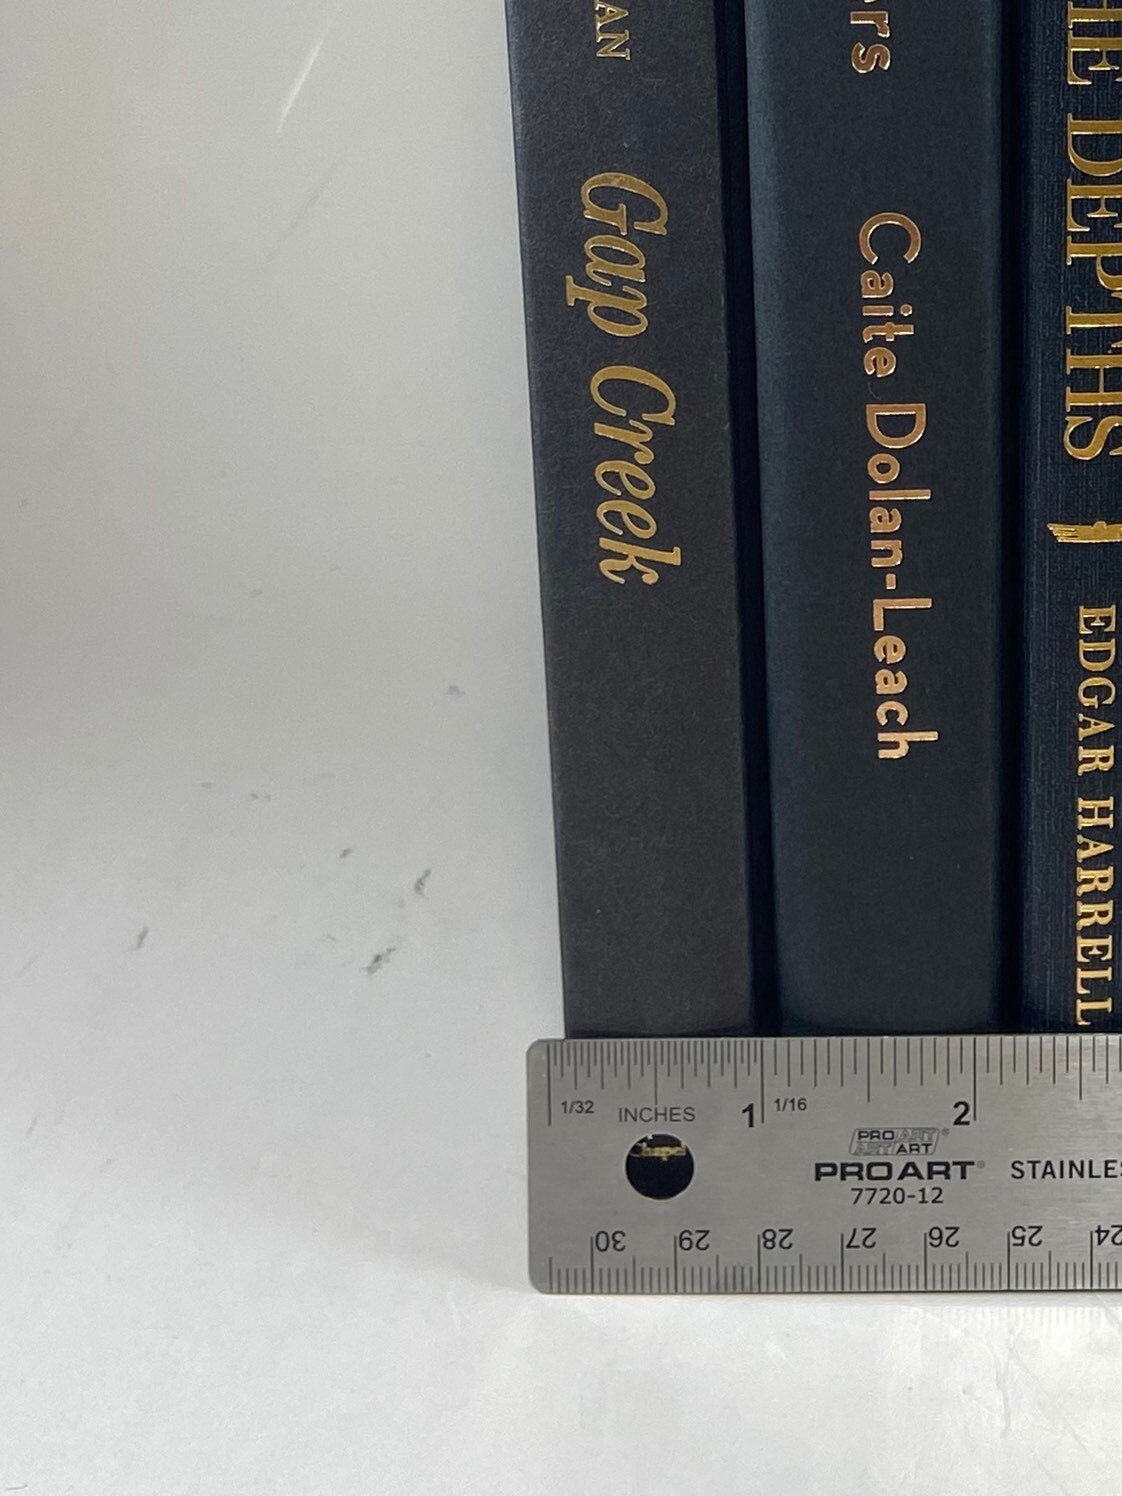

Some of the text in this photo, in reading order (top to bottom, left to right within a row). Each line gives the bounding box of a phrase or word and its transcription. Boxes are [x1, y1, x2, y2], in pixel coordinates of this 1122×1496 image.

[564, 171, 683, 585] Gap Creek
[858, 211, 940, 760] Caite Dolan-Leach
[1075, 604, 1117, 1026] EDGAR HARRELL
[560, 1099, 595, 1115] 1/32
[618, 1106, 696, 1123] INCHES
[741, 1103, 754, 1128] 1
[953, 1100, 970, 1126] 2
[774, 1097, 808, 1112] 1/16
[857, 1129, 895, 1141] PRO
[896, 1142, 933, 1155] ART
[850, 1186, 944, 1205] 7720-12
[594, 1230, 626, 1253] 30
[678, 1229, 711, 1252] 29
[761, 1228, 794, 1250] 28
[845, 1227, 877, 1249] 27
[928, 1226, 960, 1248] 26
[1011, 1225, 1043, 1247] 25
